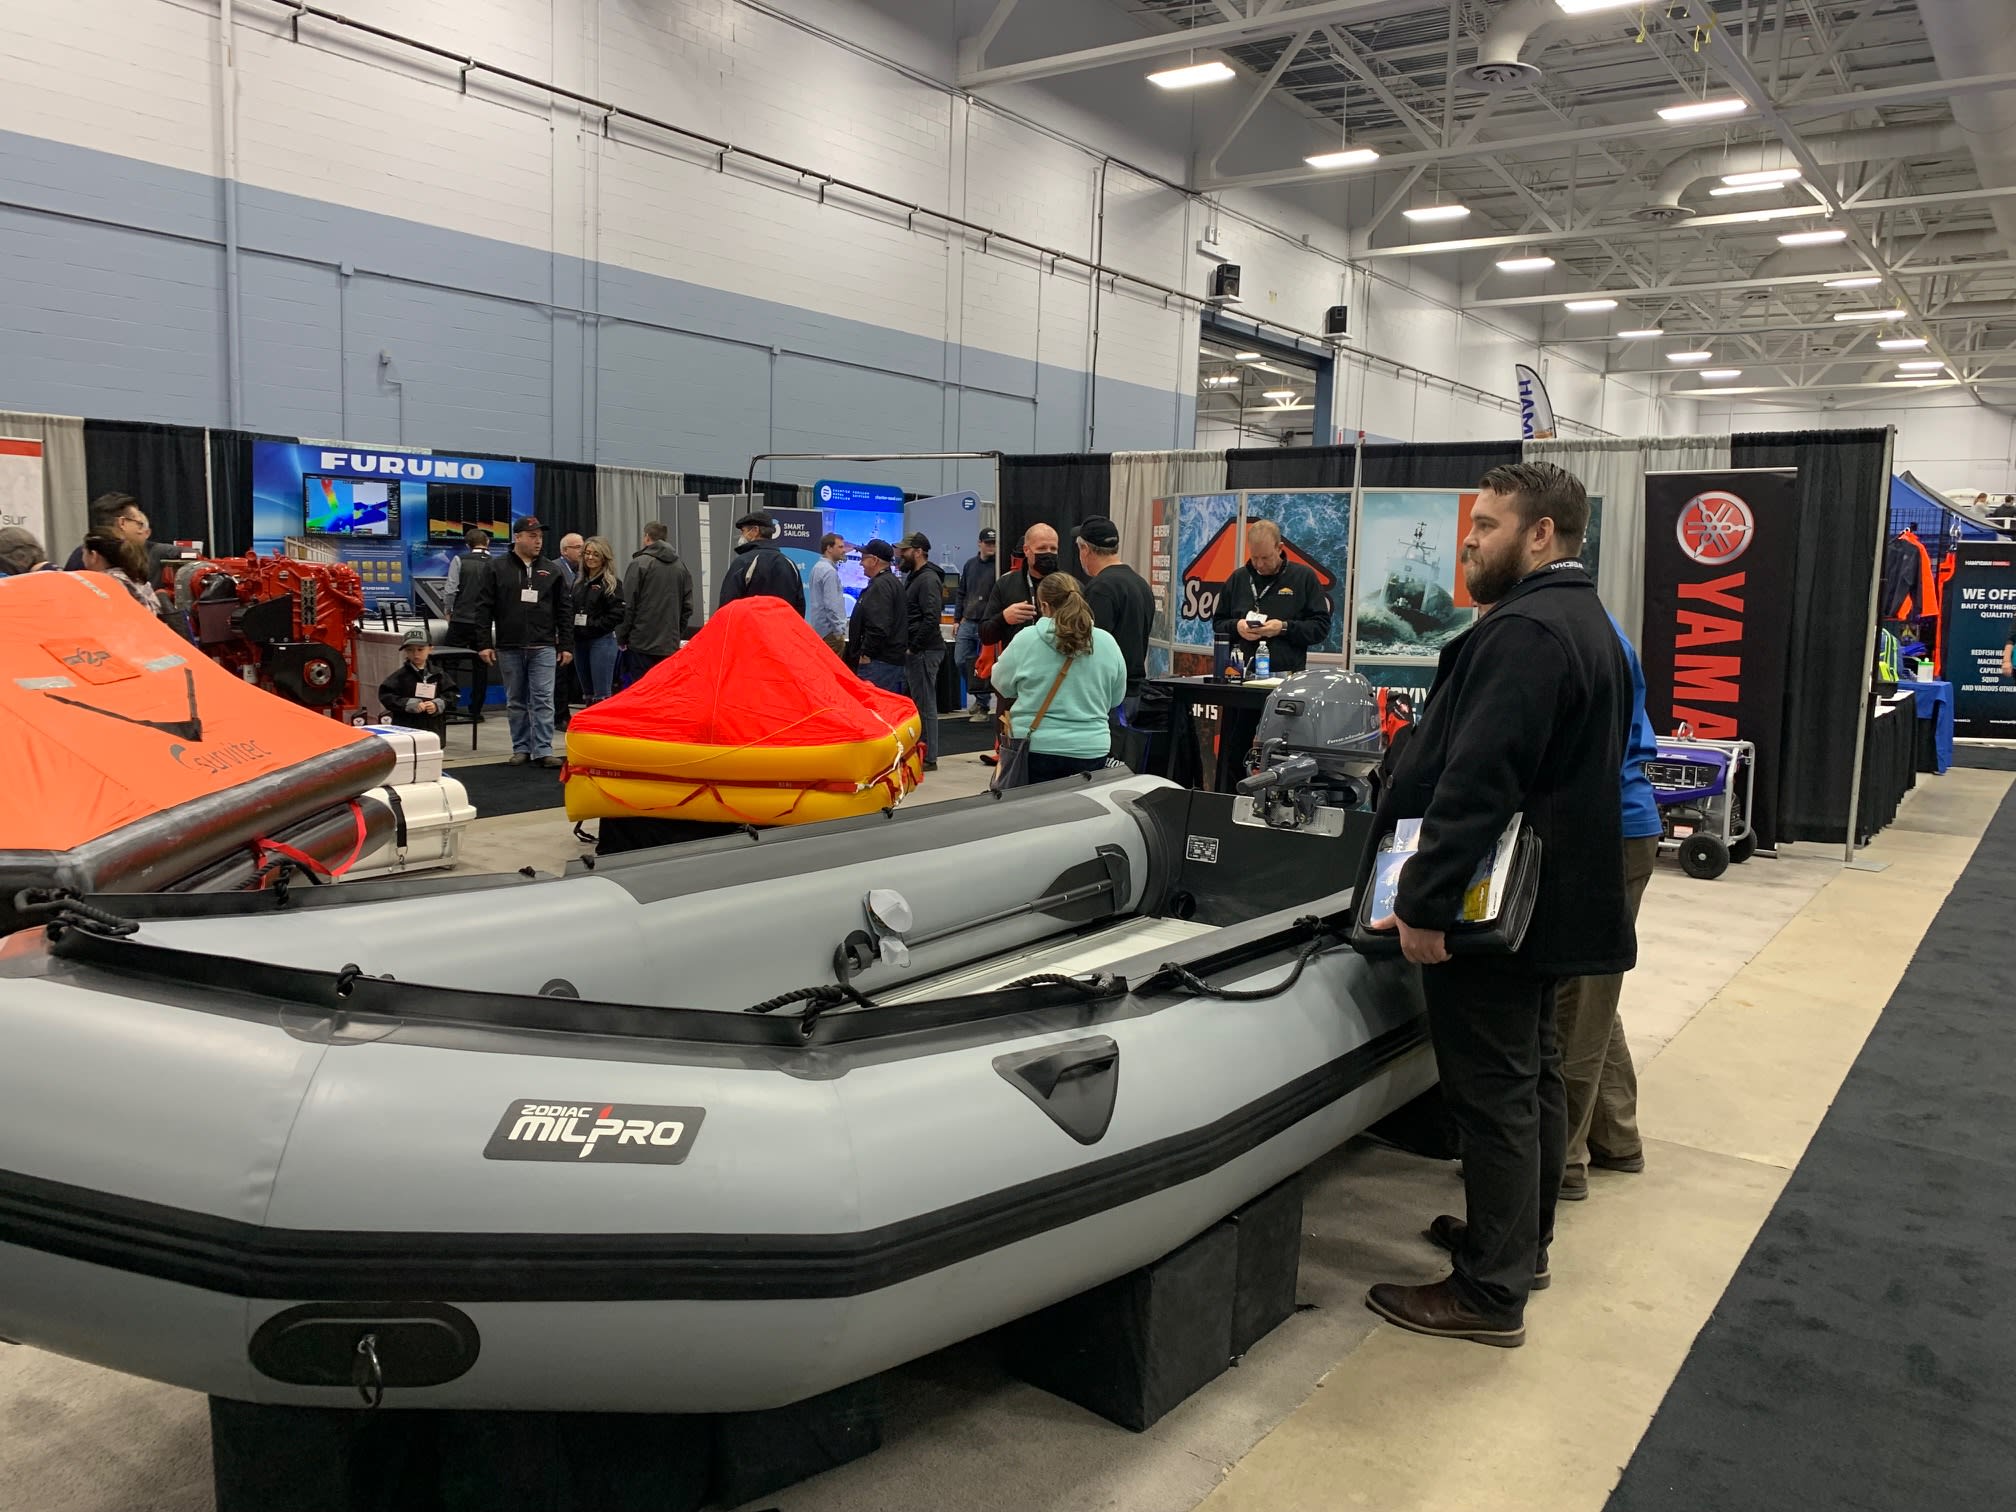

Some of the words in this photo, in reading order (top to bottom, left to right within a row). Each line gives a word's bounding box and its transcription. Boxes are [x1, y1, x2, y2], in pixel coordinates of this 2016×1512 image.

[321, 451, 484, 480] FURUNO
[784, 530, 810, 538] SAILORS
[1962, 588, 1986, 600] WE
[1988, 588, 2016, 601] OFF
[1961, 684, 1974, 692] AND
[1974, 684, 1998, 693] VARIOUS
[194, 740, 272, 774] survitec
[520, 1104, 593, 1118] ZODIAC
